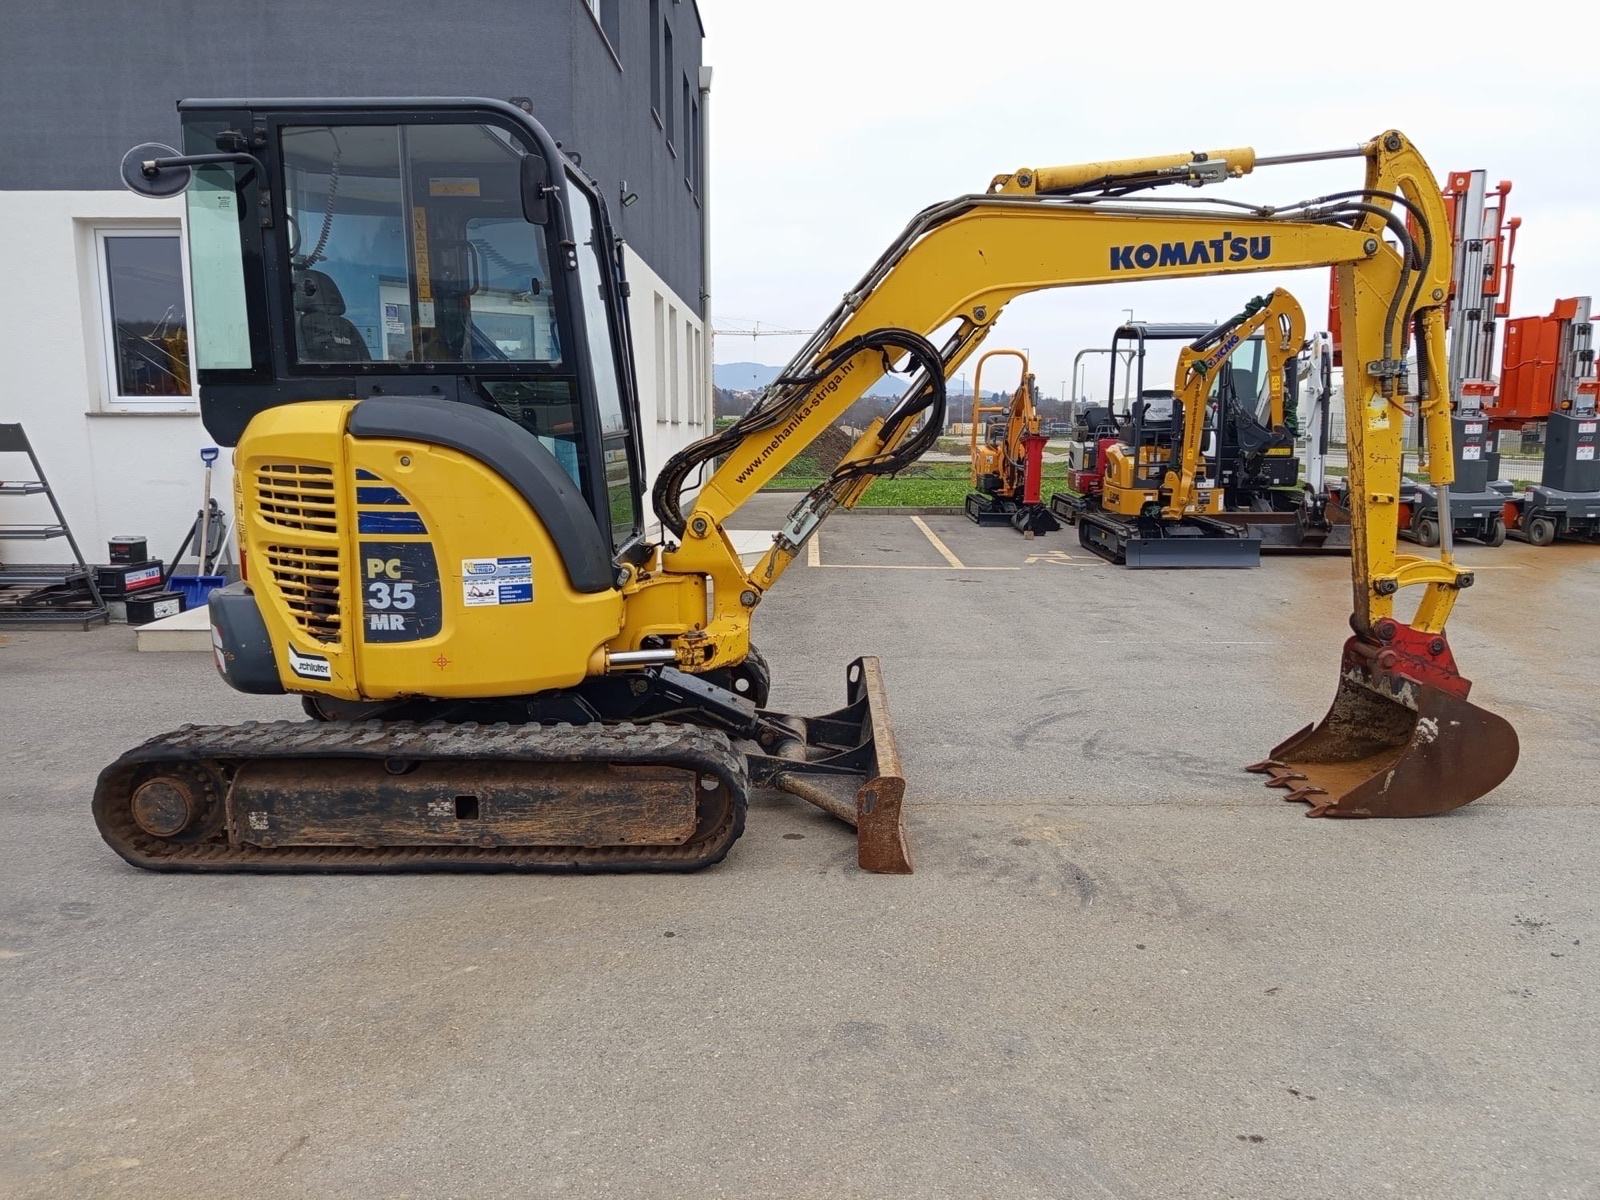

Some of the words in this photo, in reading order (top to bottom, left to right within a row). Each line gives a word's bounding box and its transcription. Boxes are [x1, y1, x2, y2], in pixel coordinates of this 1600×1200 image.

[1110, 231, 1271, 271] KOMATSU
[735, 359, 855, 484] www.mehanika-striga.hr
[366, 558, 402, 579] PC
[368, 582, 416, 610] 35
[370, 614, 406, 631] MR
